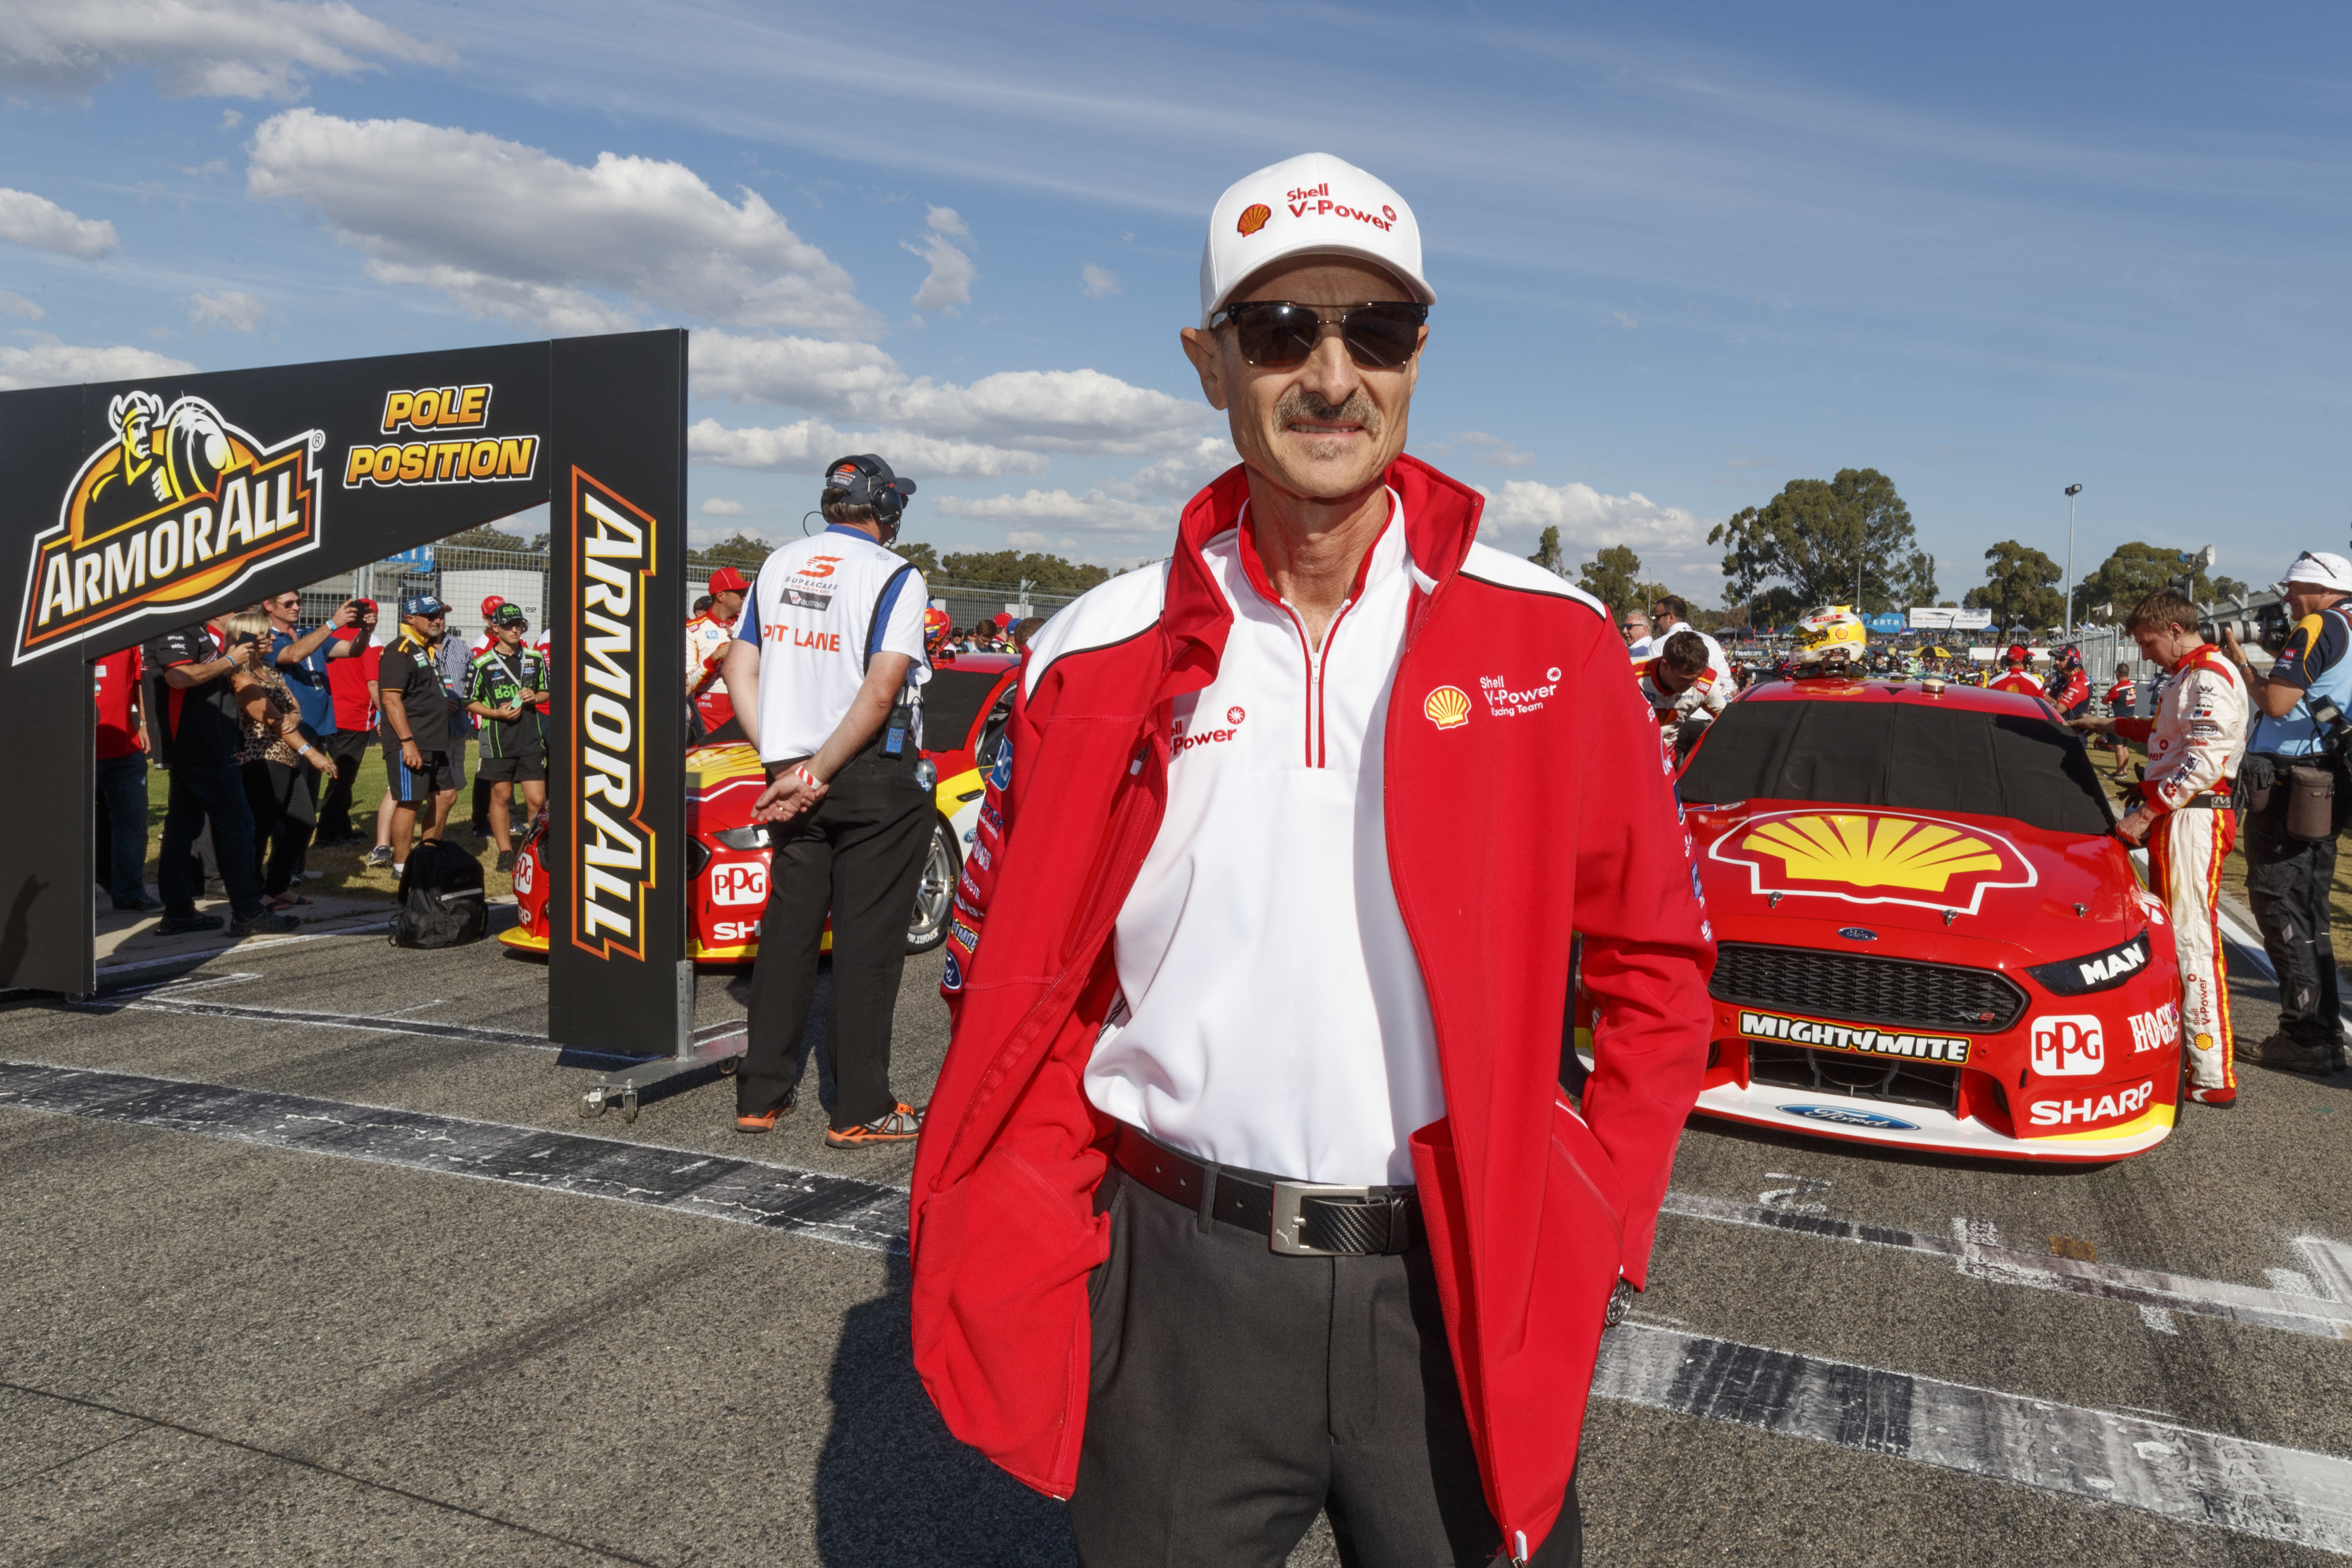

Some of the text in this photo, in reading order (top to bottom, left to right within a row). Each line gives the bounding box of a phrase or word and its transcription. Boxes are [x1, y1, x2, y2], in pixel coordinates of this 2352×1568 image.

[1287, 182, 1329, 202] Shell
[1288, 200, 1393, 232] V-Power
[382, 385, 492, 432] POLE
[345, 436, 537, 486] POSITION
[784, 576, 838, 590] SUPERCARS
[794, 628, 840, 653] LANE
[1480, 675, 1505, 689] Shell
[1484, 684, 1557, 706] V-Power
[1516, 702, 1544, 713] Team
[1170, 728, 1237, 755] Power
[714, 867, 763, 901] PPG
[2079, 943, 2146, 985] MAN
[2199, 978, 2211, 1025] V-Power
[2191, 1008, 2200, 1025] Shell
[2035, 1022, 2101, 1070] PPG
[2030, 1081, 2153, 1125] SHARP
[1804, 1108, 1891, 1127] Ford
